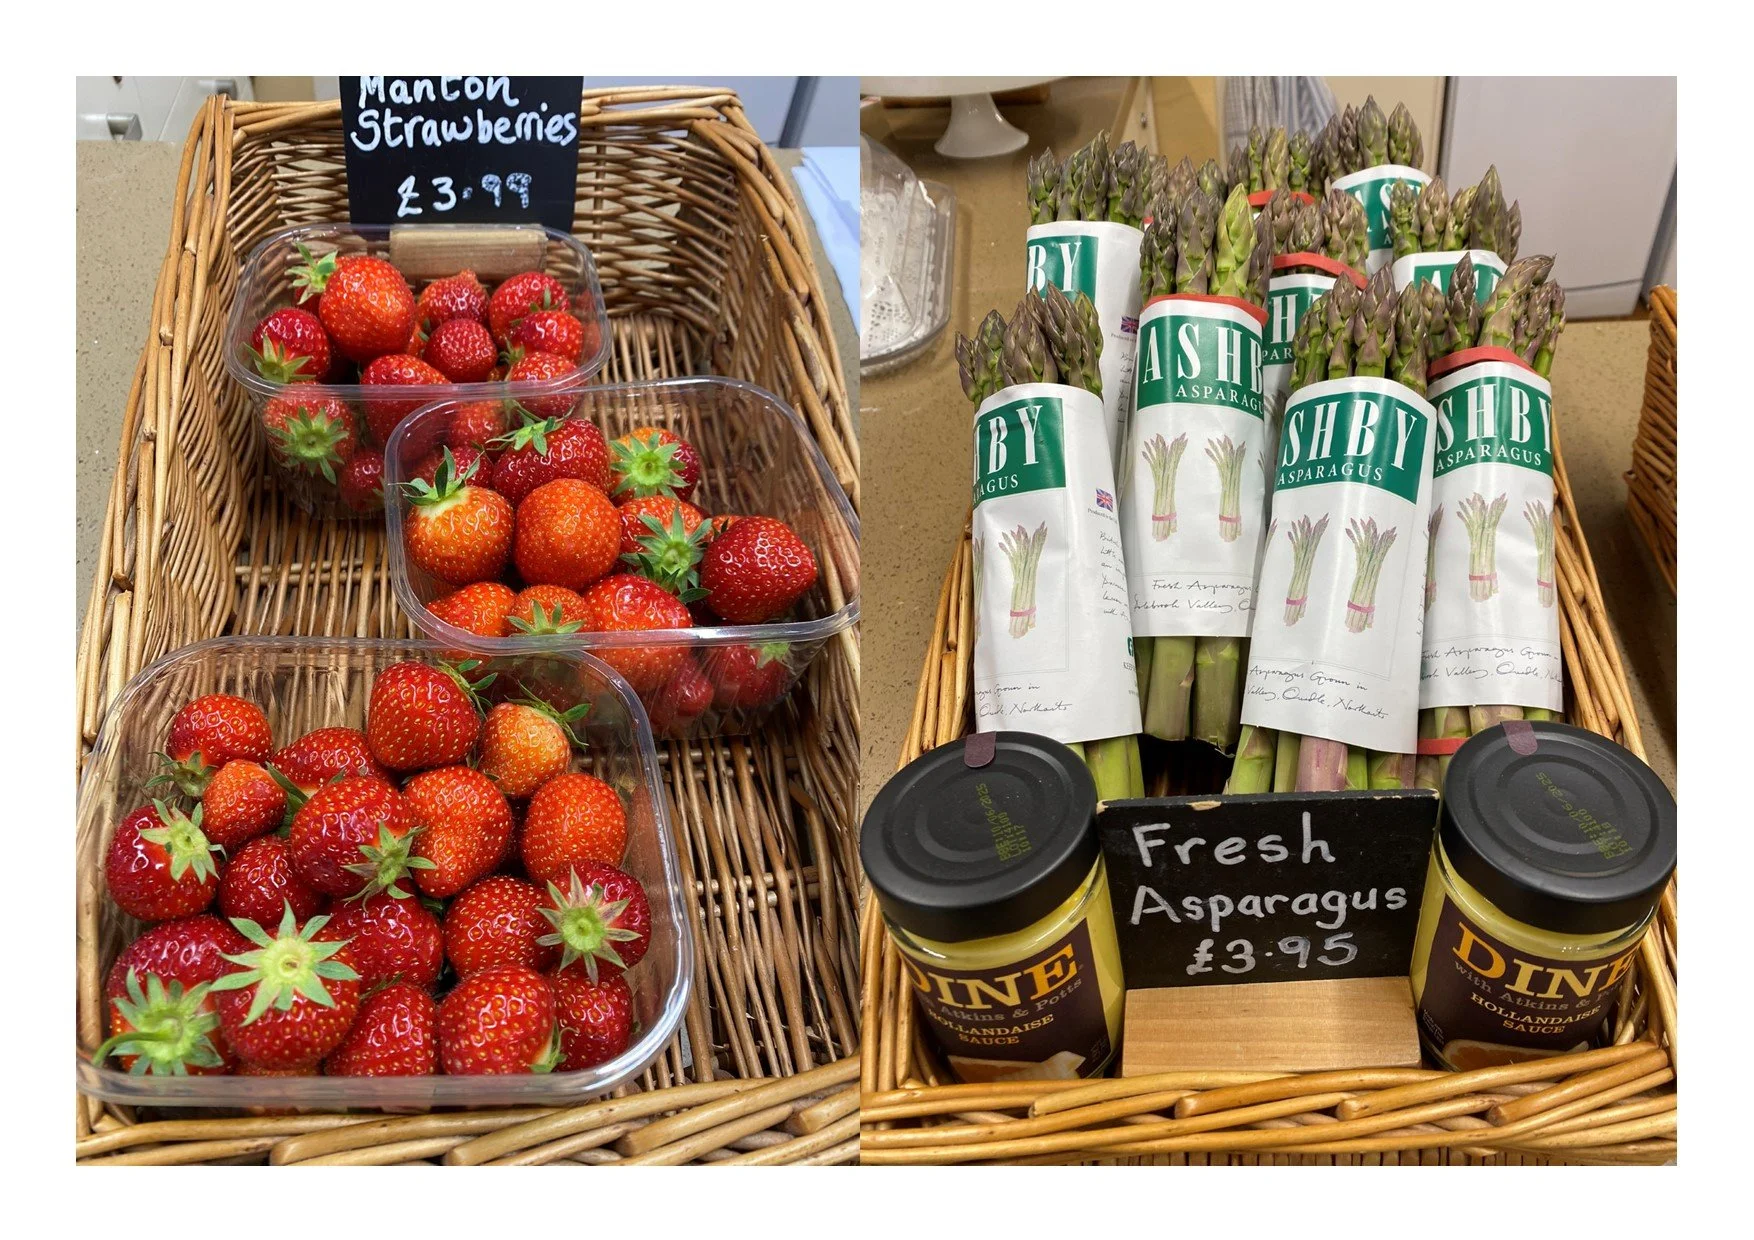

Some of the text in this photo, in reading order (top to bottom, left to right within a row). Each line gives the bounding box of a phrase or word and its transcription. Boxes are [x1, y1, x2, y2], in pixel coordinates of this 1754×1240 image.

[358, 76, 519, 108] Manton
[350, 102, 577, 151] Strawberries
[1282, 399, 1417, 470] SHBY
[1437, 384, 1551, 454] SHBY
[1277, 462, 1383, 486] ASPARAGUS
[1436, 443, 1541, 472] ASPARAGUS
[1132, 811, 1336, 867] Fresh
[1131, 885, 1408, 932] Asparagus
[1452, 921, 1642, 999] DINE
[941, 978, 1082, 1022] Atkins & Potts
[1470, 991, 1601, 1025] HOLLANDAISE
[1499, 991, 1569, 1011] Atkins
[1576, 999, 1590, 1009] &
[928, 1009, 1054, 1036] HOLLANDAISE
[958, 1033, 1020, 1046] SAUCE
[1502, 1019, 1566, 1034] SAUCE
